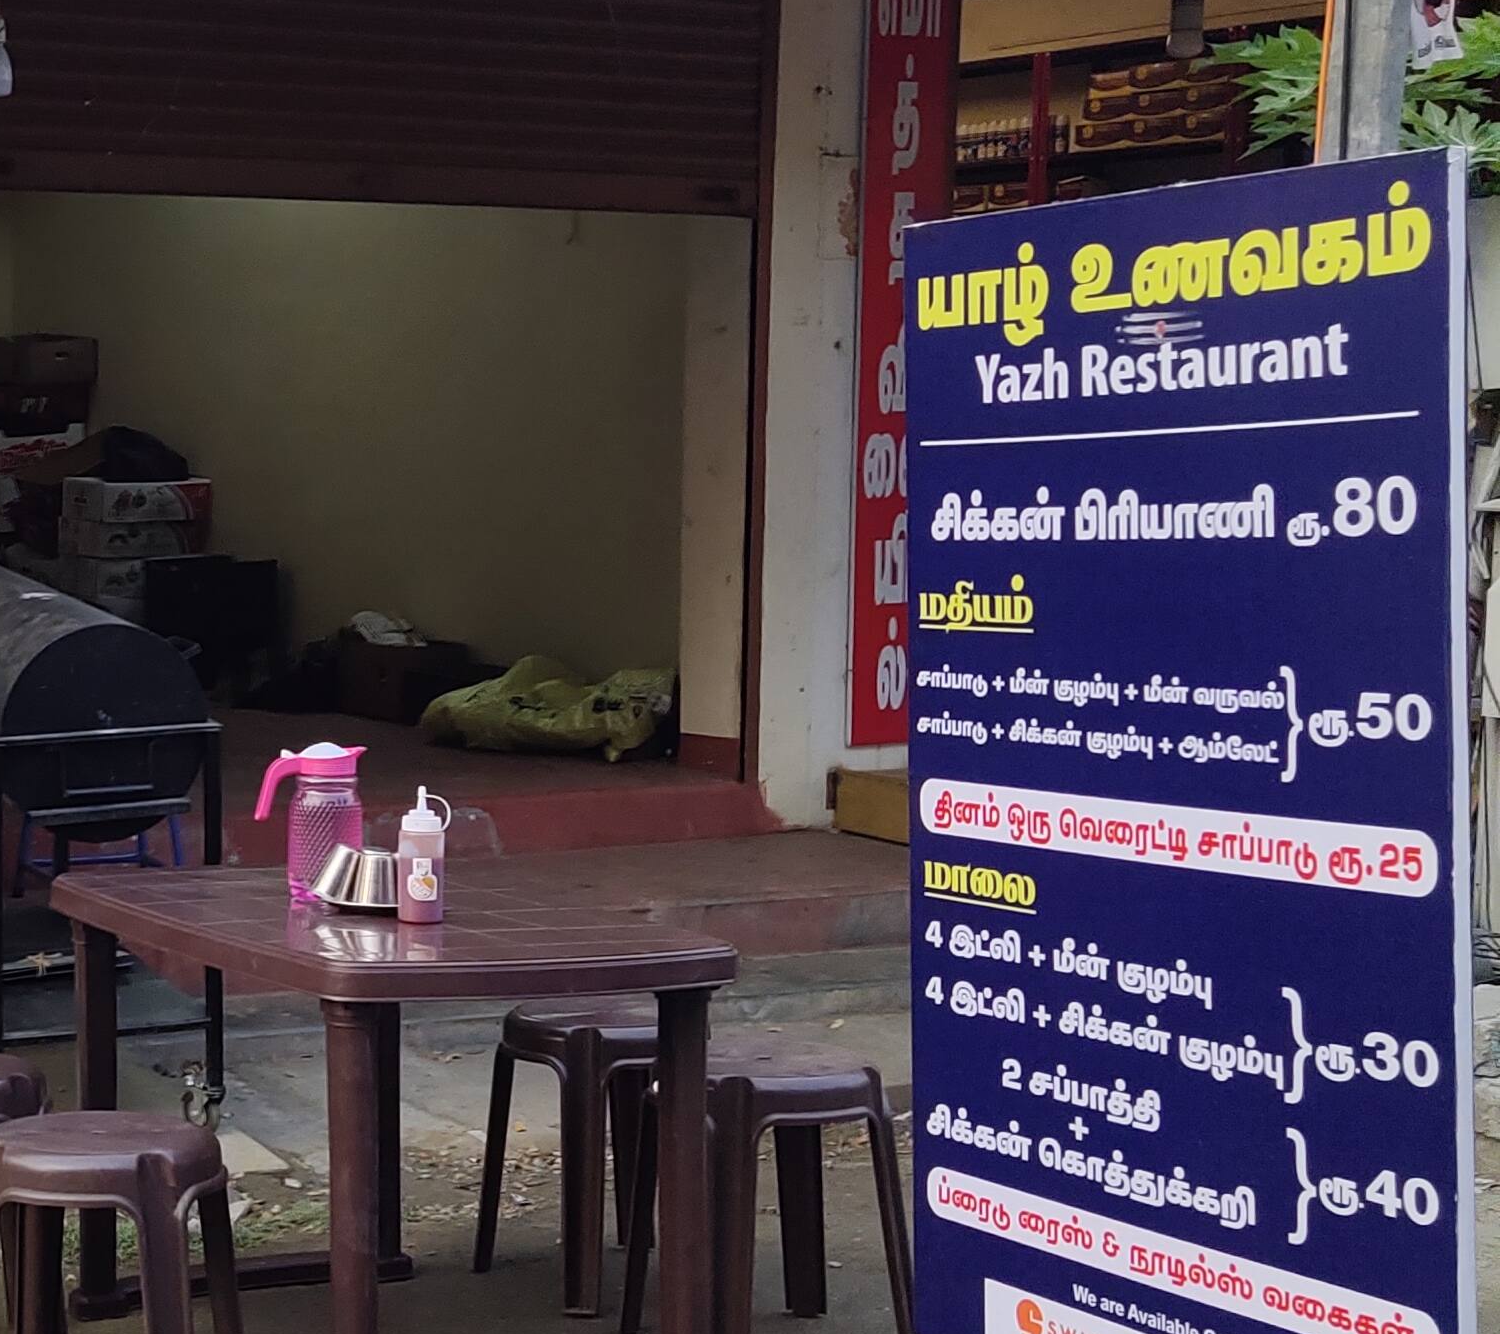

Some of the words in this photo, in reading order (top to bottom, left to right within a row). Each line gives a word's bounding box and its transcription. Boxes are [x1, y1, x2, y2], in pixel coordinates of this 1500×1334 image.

[917, 241, 1049, 346] யாழ்
[1070, 180, 1433, 314] உணவகம்
[974, 346, 1070, 404] Yazh
[1080, 323, 1349, 397] Restaurant
[930, 485, 1066, 542] சிக்கன்
[1073, 482, 1276, 542] பிரியாணி
[918, 573, 1035, 629] மதியம்
[915, 663, 989, 698] சாப்பாடு
[992, 676, 1006, 692] +
[1008, 667, 1050, 696] மீன்
[1053, 672, 1120, 708] குழம்பு
[1123, 684, 1139, 701] +
[1142, 674, 1190, 705] மீன்
[1192, 681, 1286, 714] வருவல்
[915, 711, 988, 745] சாப்பாடு
[991, 724, 1006, 740] +
[1008, 718, 1082, 748] சிக்கன்
[1085, 726, 1154, 760] குழம்பு
[1157, 736, 1174, 755] +
[1177, 732, 1280, 764] ஆம்லேட்
[933, 790, 1001, 829] தினம்
[1007, 802, 1052, 845] ஒரு
[1059, 806, 1189, 862] வெரைட்டி
[1197, 821, 1319, 881] சாப்பாடு
[923, 859, 1037, 906] மாலை
[924, 920, 943, 949] 4
[948, 925, 1021, 964] இட்லி
[1027, 945, 1047, 967] +
[1052, 936, 1110, 981] மீன்
[1115, 958, 1213, 1010] குழம்பு
[924, 976, 944, 1005] 4
[949, 981, 1026, 1025] இட்லி
[1031, 1005, 1052, 1028] +
[1058, 1003, 1171, 1056] சிக்கன்
[1178, 1034, 1284, 1091] குழம்பு
[1001, 1057, 1022, 1089] 2
[1028, 1063, 1161, 1133] சப்பாத்தி
[926, 1103, 1032, 1162] சிக்கன்
[1038, 1138, 1257, 1230] கொத்துக்கறி
[938, 1174, 1011, 1231] ப்ரைடு
[1018, 1214, 1093, 1250] ரைஸ்
[1102, 1232, 1121, 1259] &
[1129, 1244, 1253, 1301] நூடில்ஸ்
[1072, 1283, 1097, 1308] We
[1100, 1296, 1125, 1317] are
